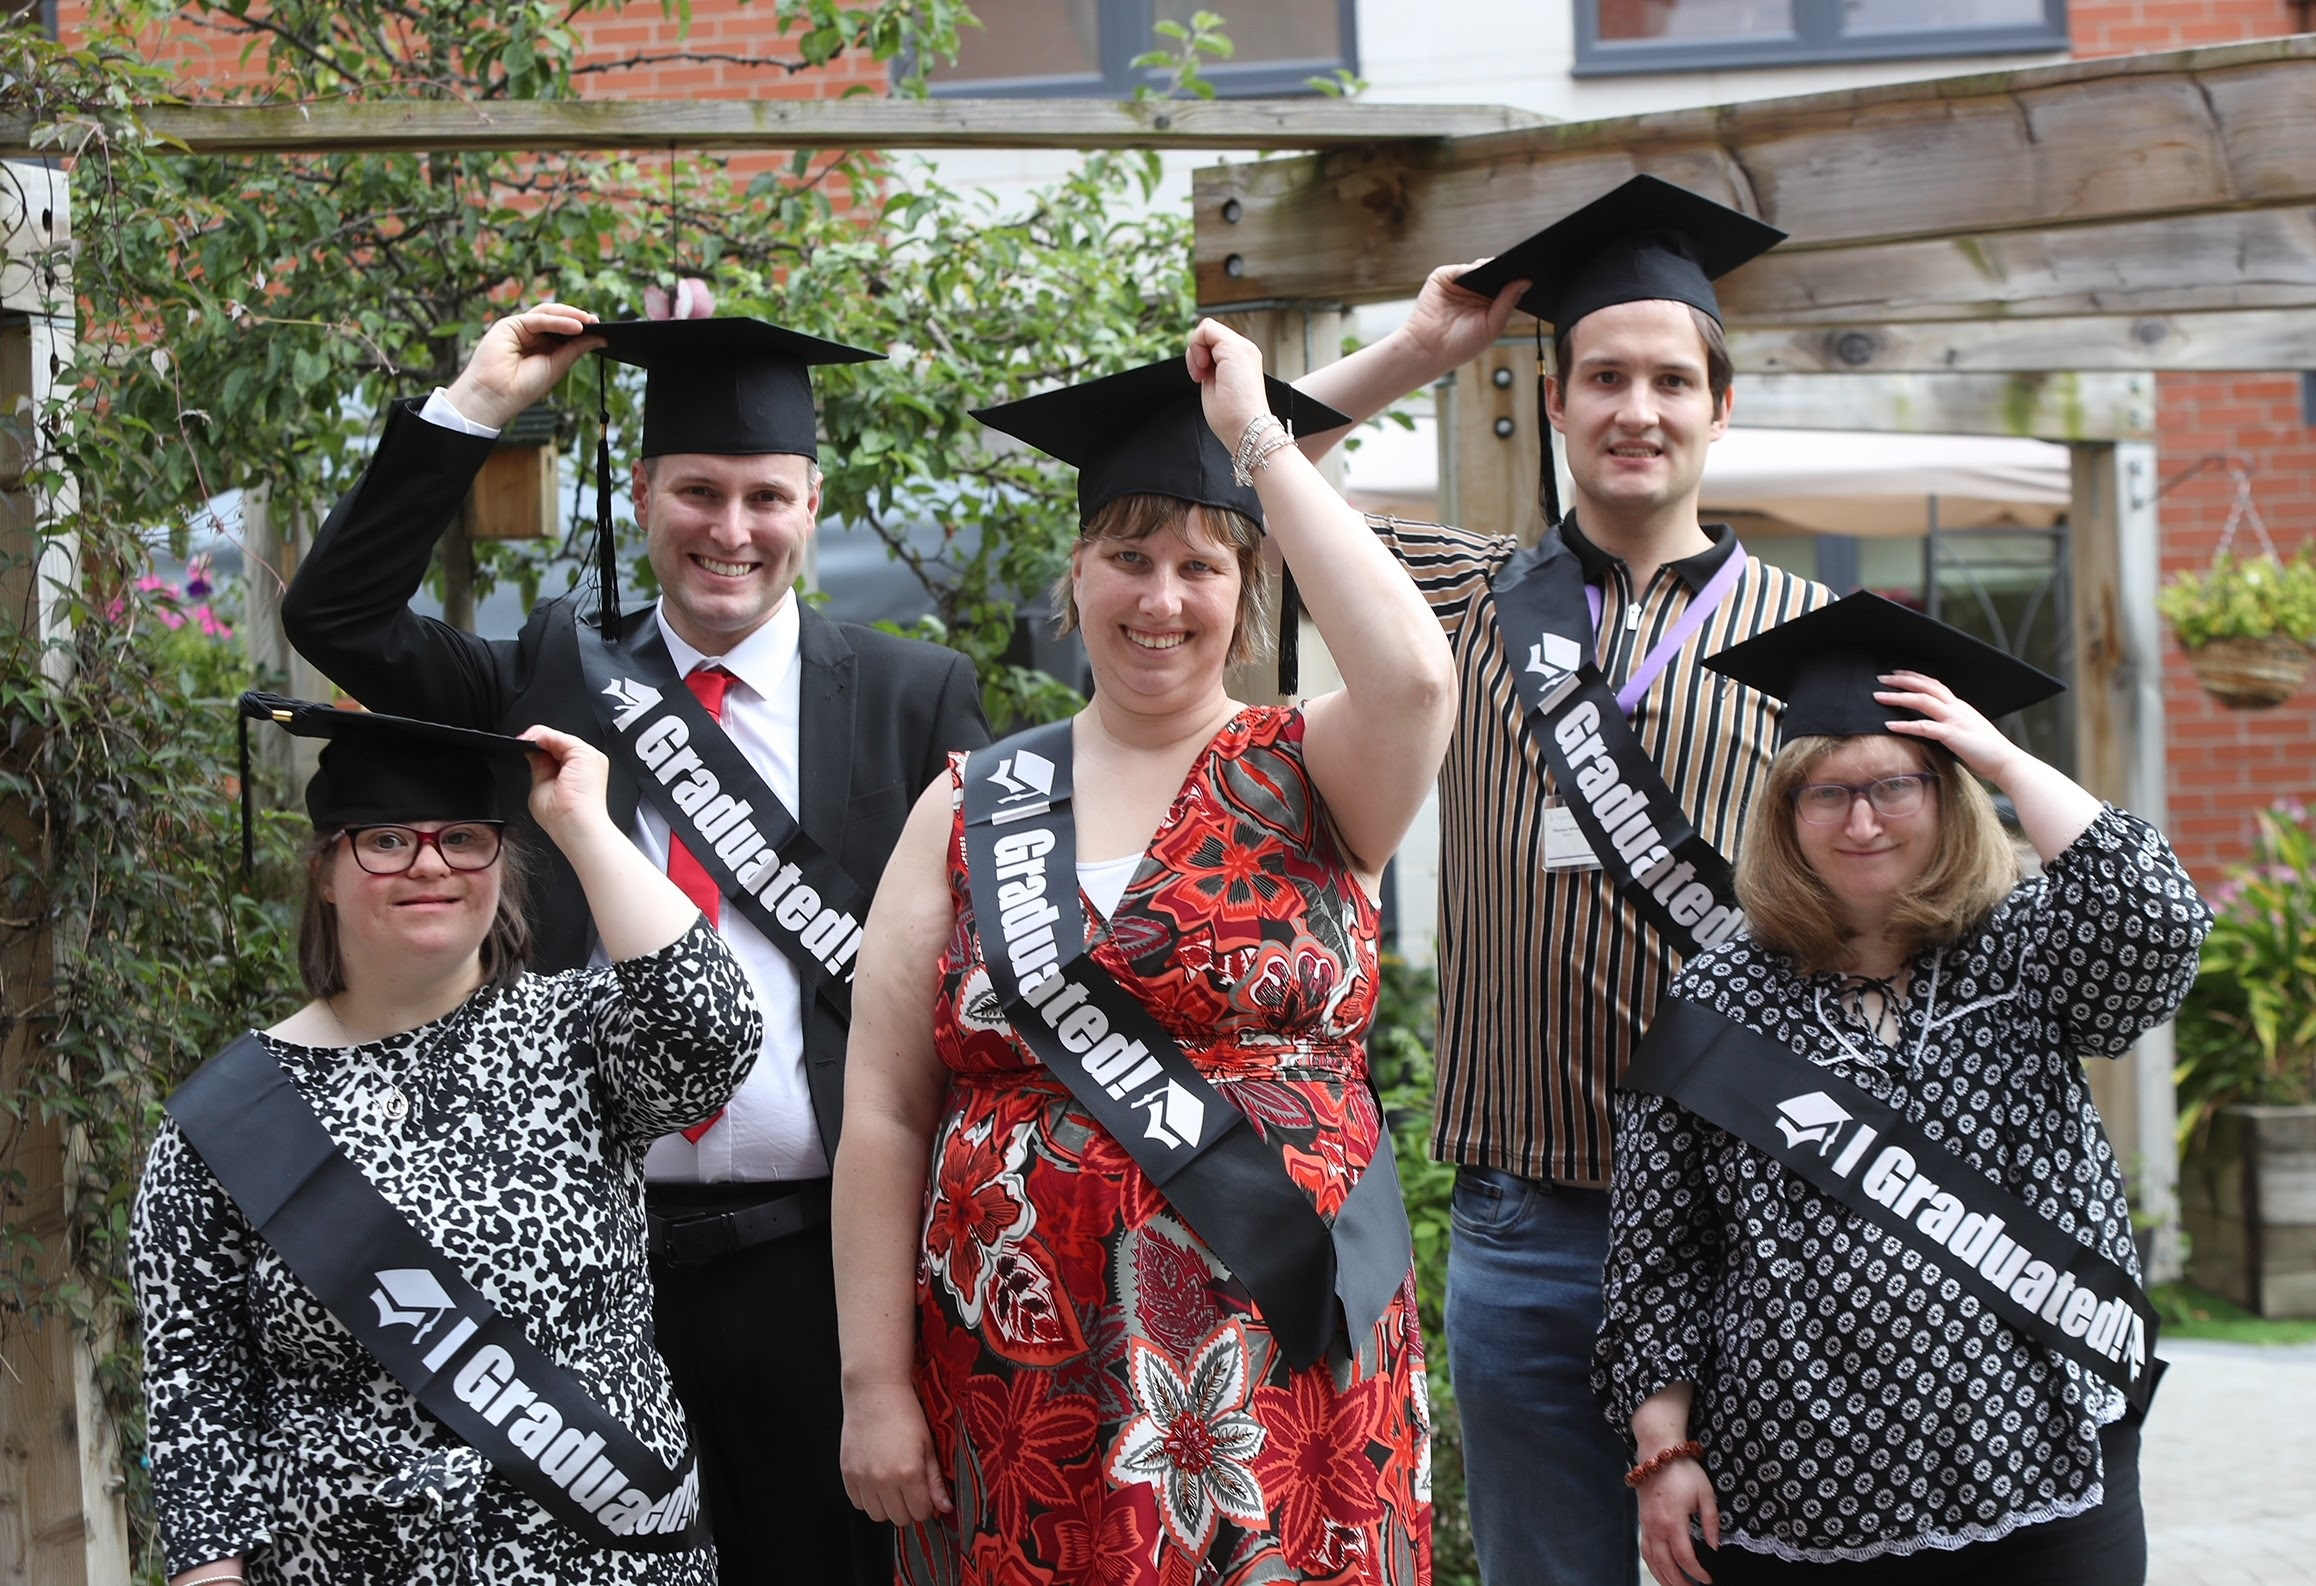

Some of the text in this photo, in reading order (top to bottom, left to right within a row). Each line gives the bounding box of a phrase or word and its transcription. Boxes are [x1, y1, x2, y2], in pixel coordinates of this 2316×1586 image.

[635, 715, 864, 976] Graduated!
[1537, 672, 1746, 951] I Graduated
[991, 800, 1164, 1101] I Graduated!
[421, 1317, 478, 1373] I
[1831, 1124, 2133, 1363] I Graduated!
